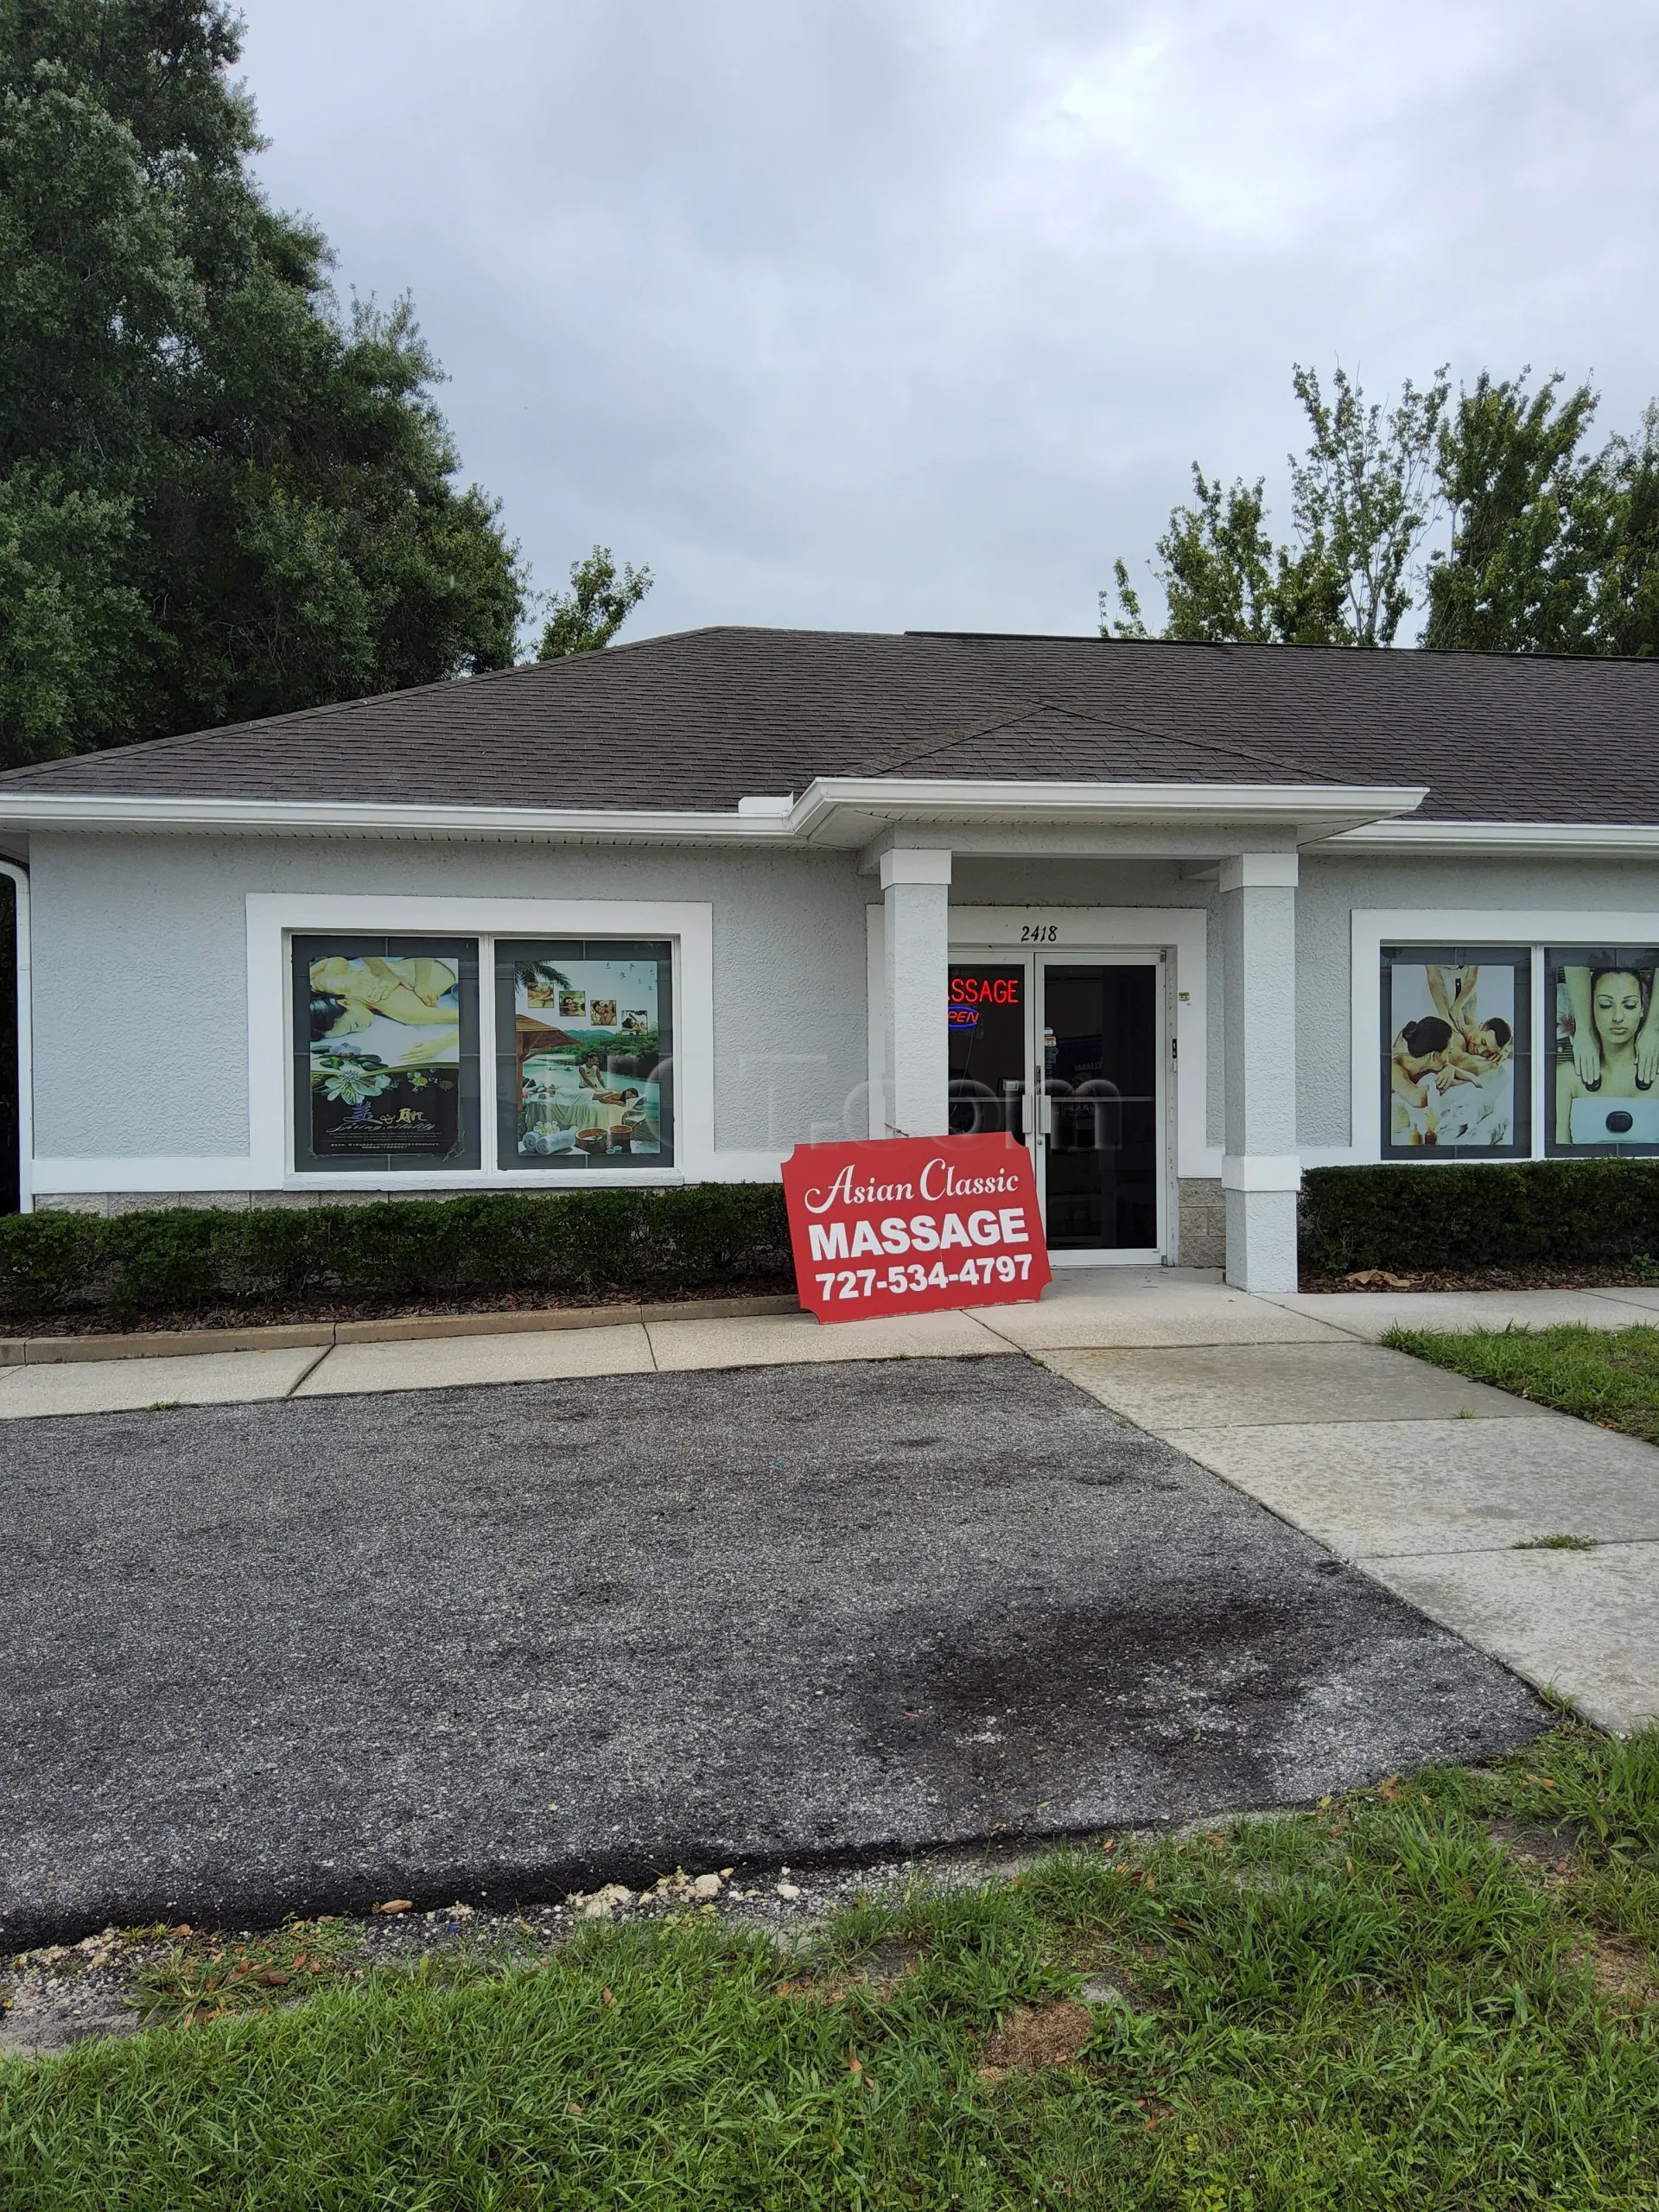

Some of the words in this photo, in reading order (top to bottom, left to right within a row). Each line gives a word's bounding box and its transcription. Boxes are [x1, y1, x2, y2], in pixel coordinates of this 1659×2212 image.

[1020, 925, 1058, 943] 2418
[947, 978, 1019, 1003] SSAGE
[804, 1164, 914, 1214] Asian
[919, 1158, 1019, 1201] Classic
[808, 1207, 1029, 1262] MASSAGE
[815, 1253, 1033, 1301] 727-534-4797
